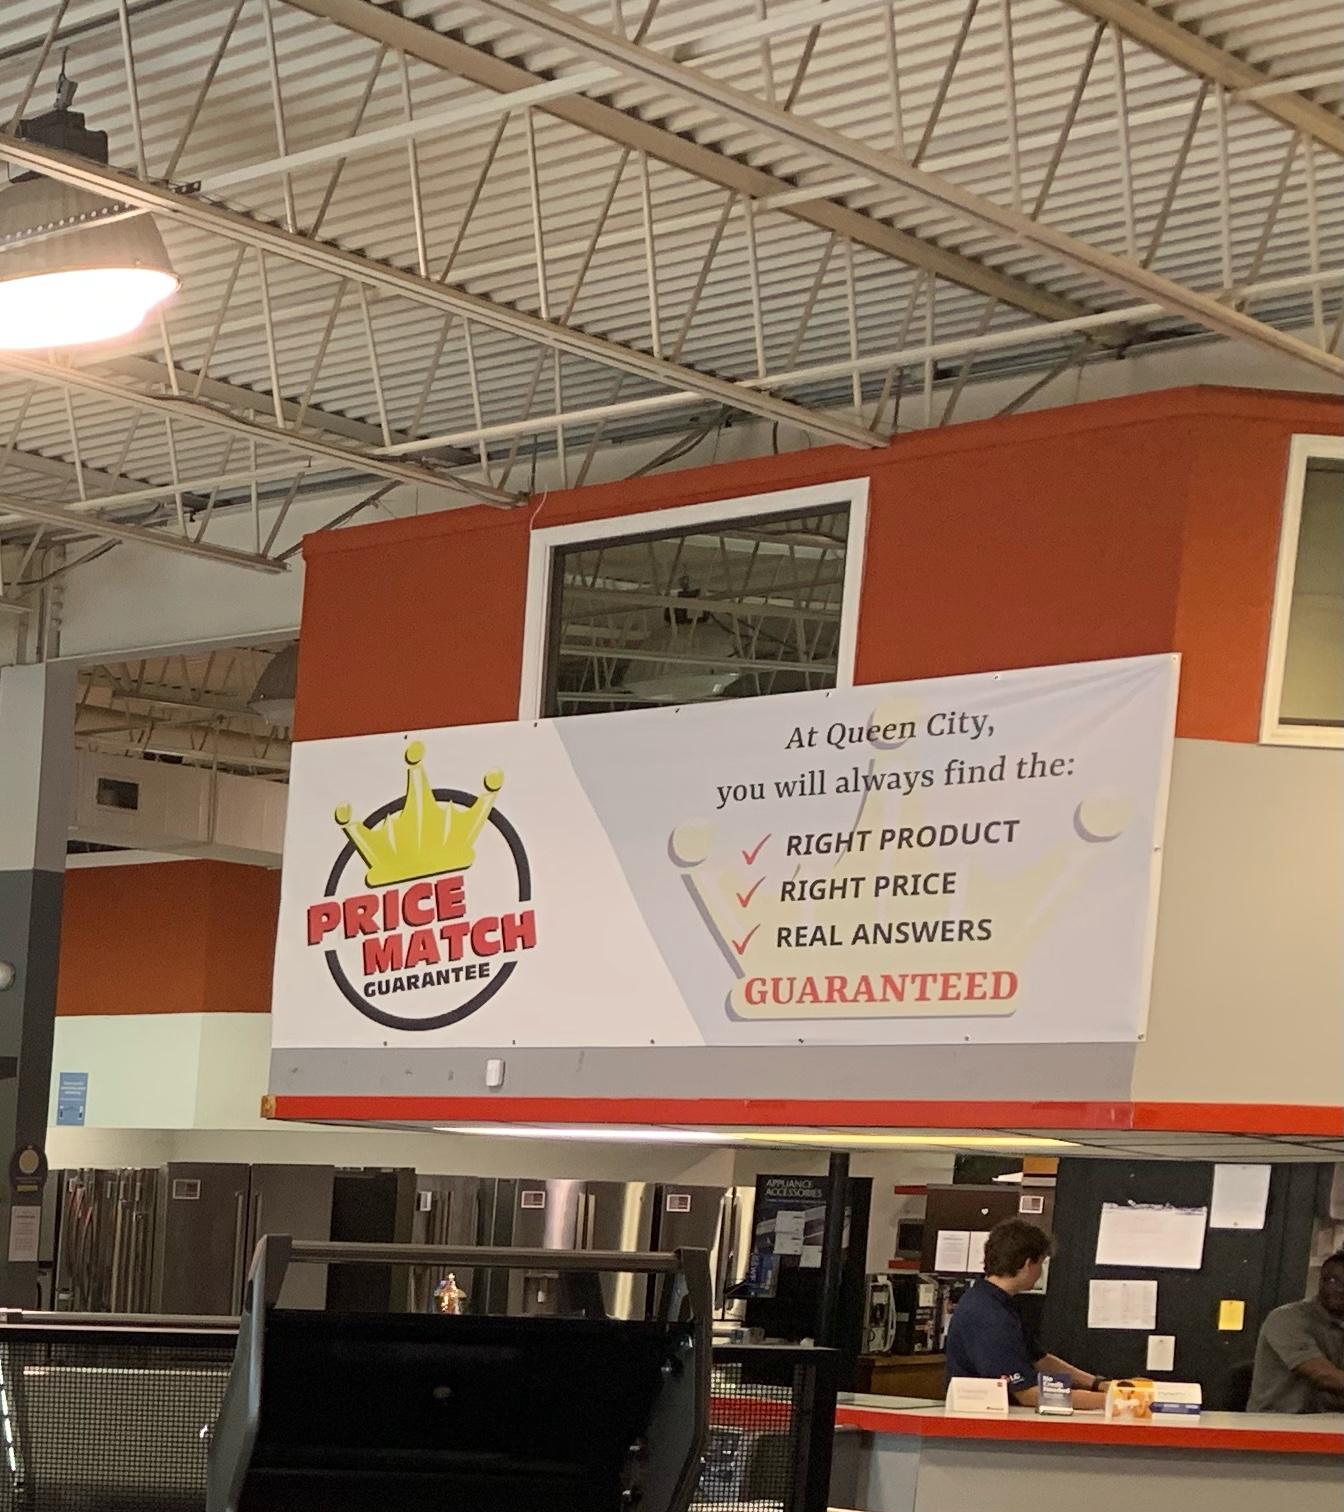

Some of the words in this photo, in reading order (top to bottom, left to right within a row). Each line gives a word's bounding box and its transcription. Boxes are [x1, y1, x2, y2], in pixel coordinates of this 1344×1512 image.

[784, 726, 818, 750] At
[826, 720, 917, 750] Queen
[926, 711, 996, 740] City,
[716, 782, 766, 809] you
[775, 770, 827, 799] will
[835, 765, 936, 797] always
[944, 755, 1007, 787] find
[1016, 752, 1077, 780] the:
[786, 829, 872, 857] RIGHT
[879, 819, 1021, 851] PRODUCT
[780, 876, 866, 902] RIGHT
[873, 872, 957, 898] PRICE
[307, 875, 468, 947] PRICE
[362, 909, 538, 978] MATCH
[776, 925, 844, 948] REAL
[850, 919, 993, 946] ANSWERS
[363, 962, 491, 998] GUARANTEE
[744, 970, 1019, 1006] GUARANTEED
[765, 1188, 823, 1198] ACCESSORIES
